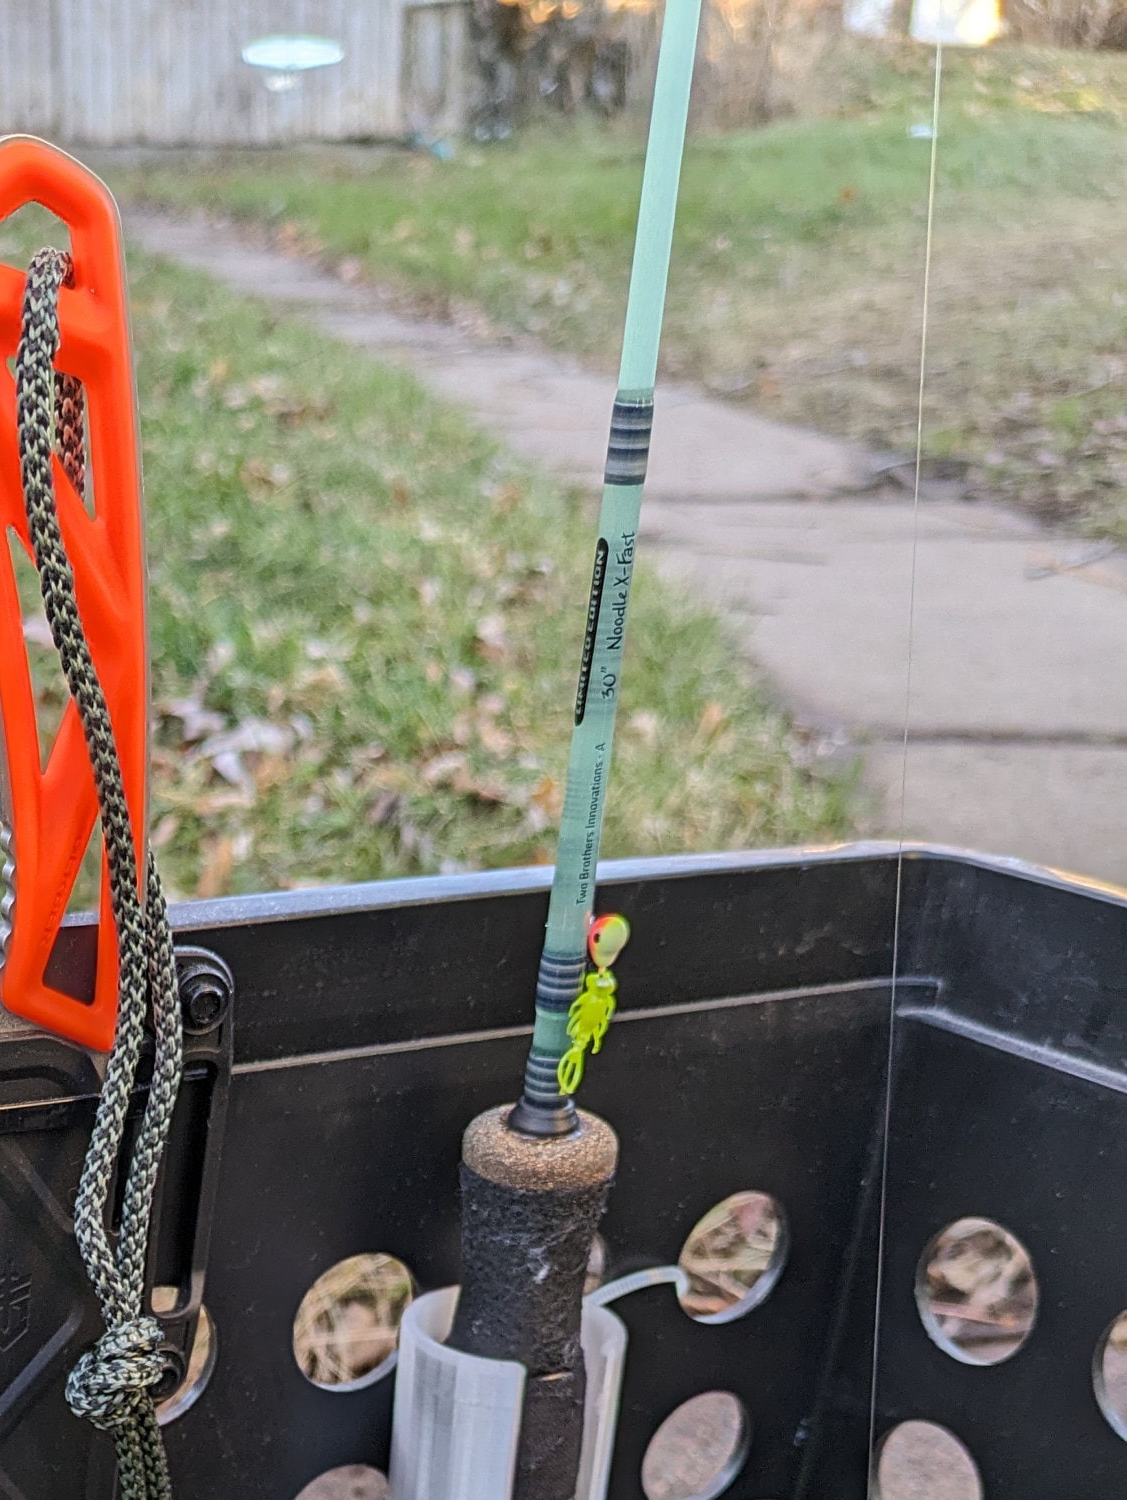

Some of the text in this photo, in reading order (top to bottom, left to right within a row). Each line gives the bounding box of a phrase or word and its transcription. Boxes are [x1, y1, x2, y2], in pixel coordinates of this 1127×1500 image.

[601, 531, 635, 700] 30" Noodle X-Fast
[585, 761, 603, 830] Innovations
[579, 831, 594, 880] Brothers
[576, 882, 587, 906] Two
